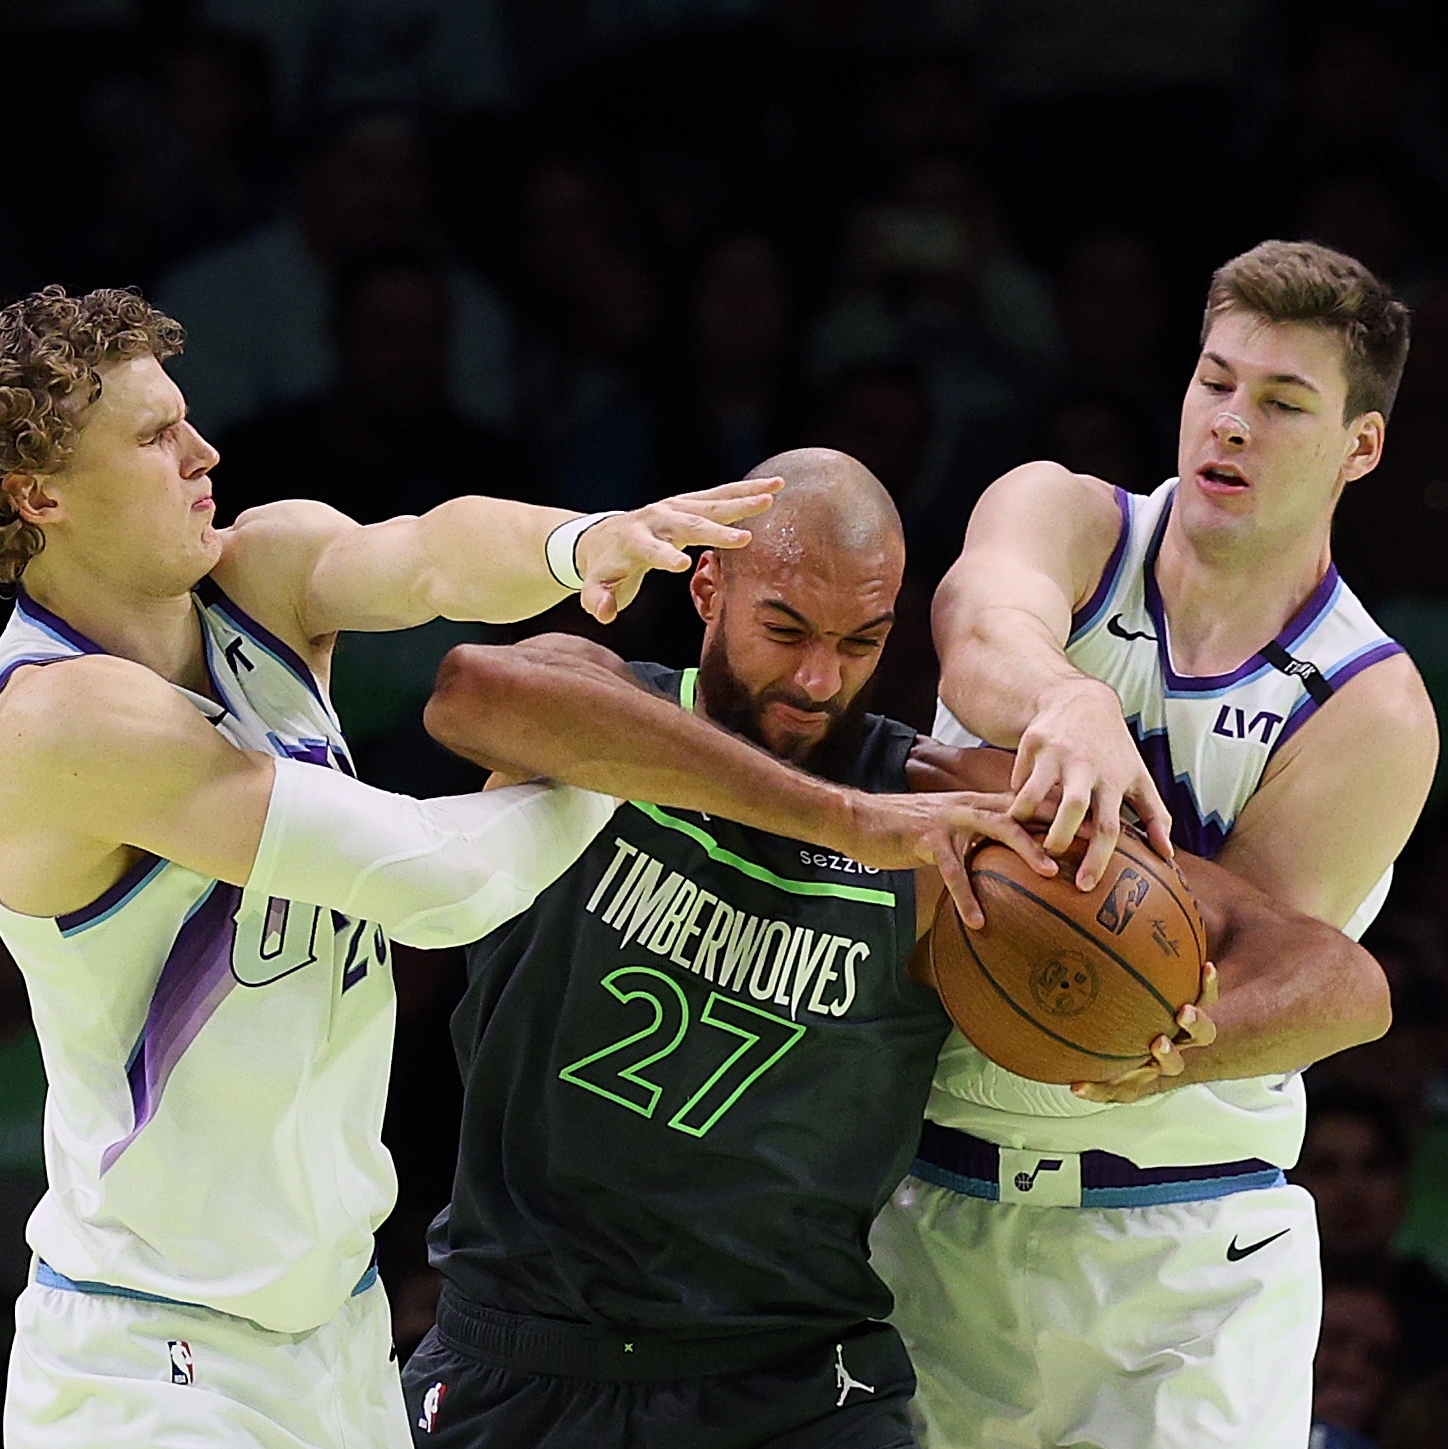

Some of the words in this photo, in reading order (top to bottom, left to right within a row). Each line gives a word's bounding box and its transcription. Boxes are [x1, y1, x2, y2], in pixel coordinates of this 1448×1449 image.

[1212, 704, 1284, 745] LVT
[586, 837, 871, 1021] TIMBERWOLVES
[559, 966, 806, 1138] 27
